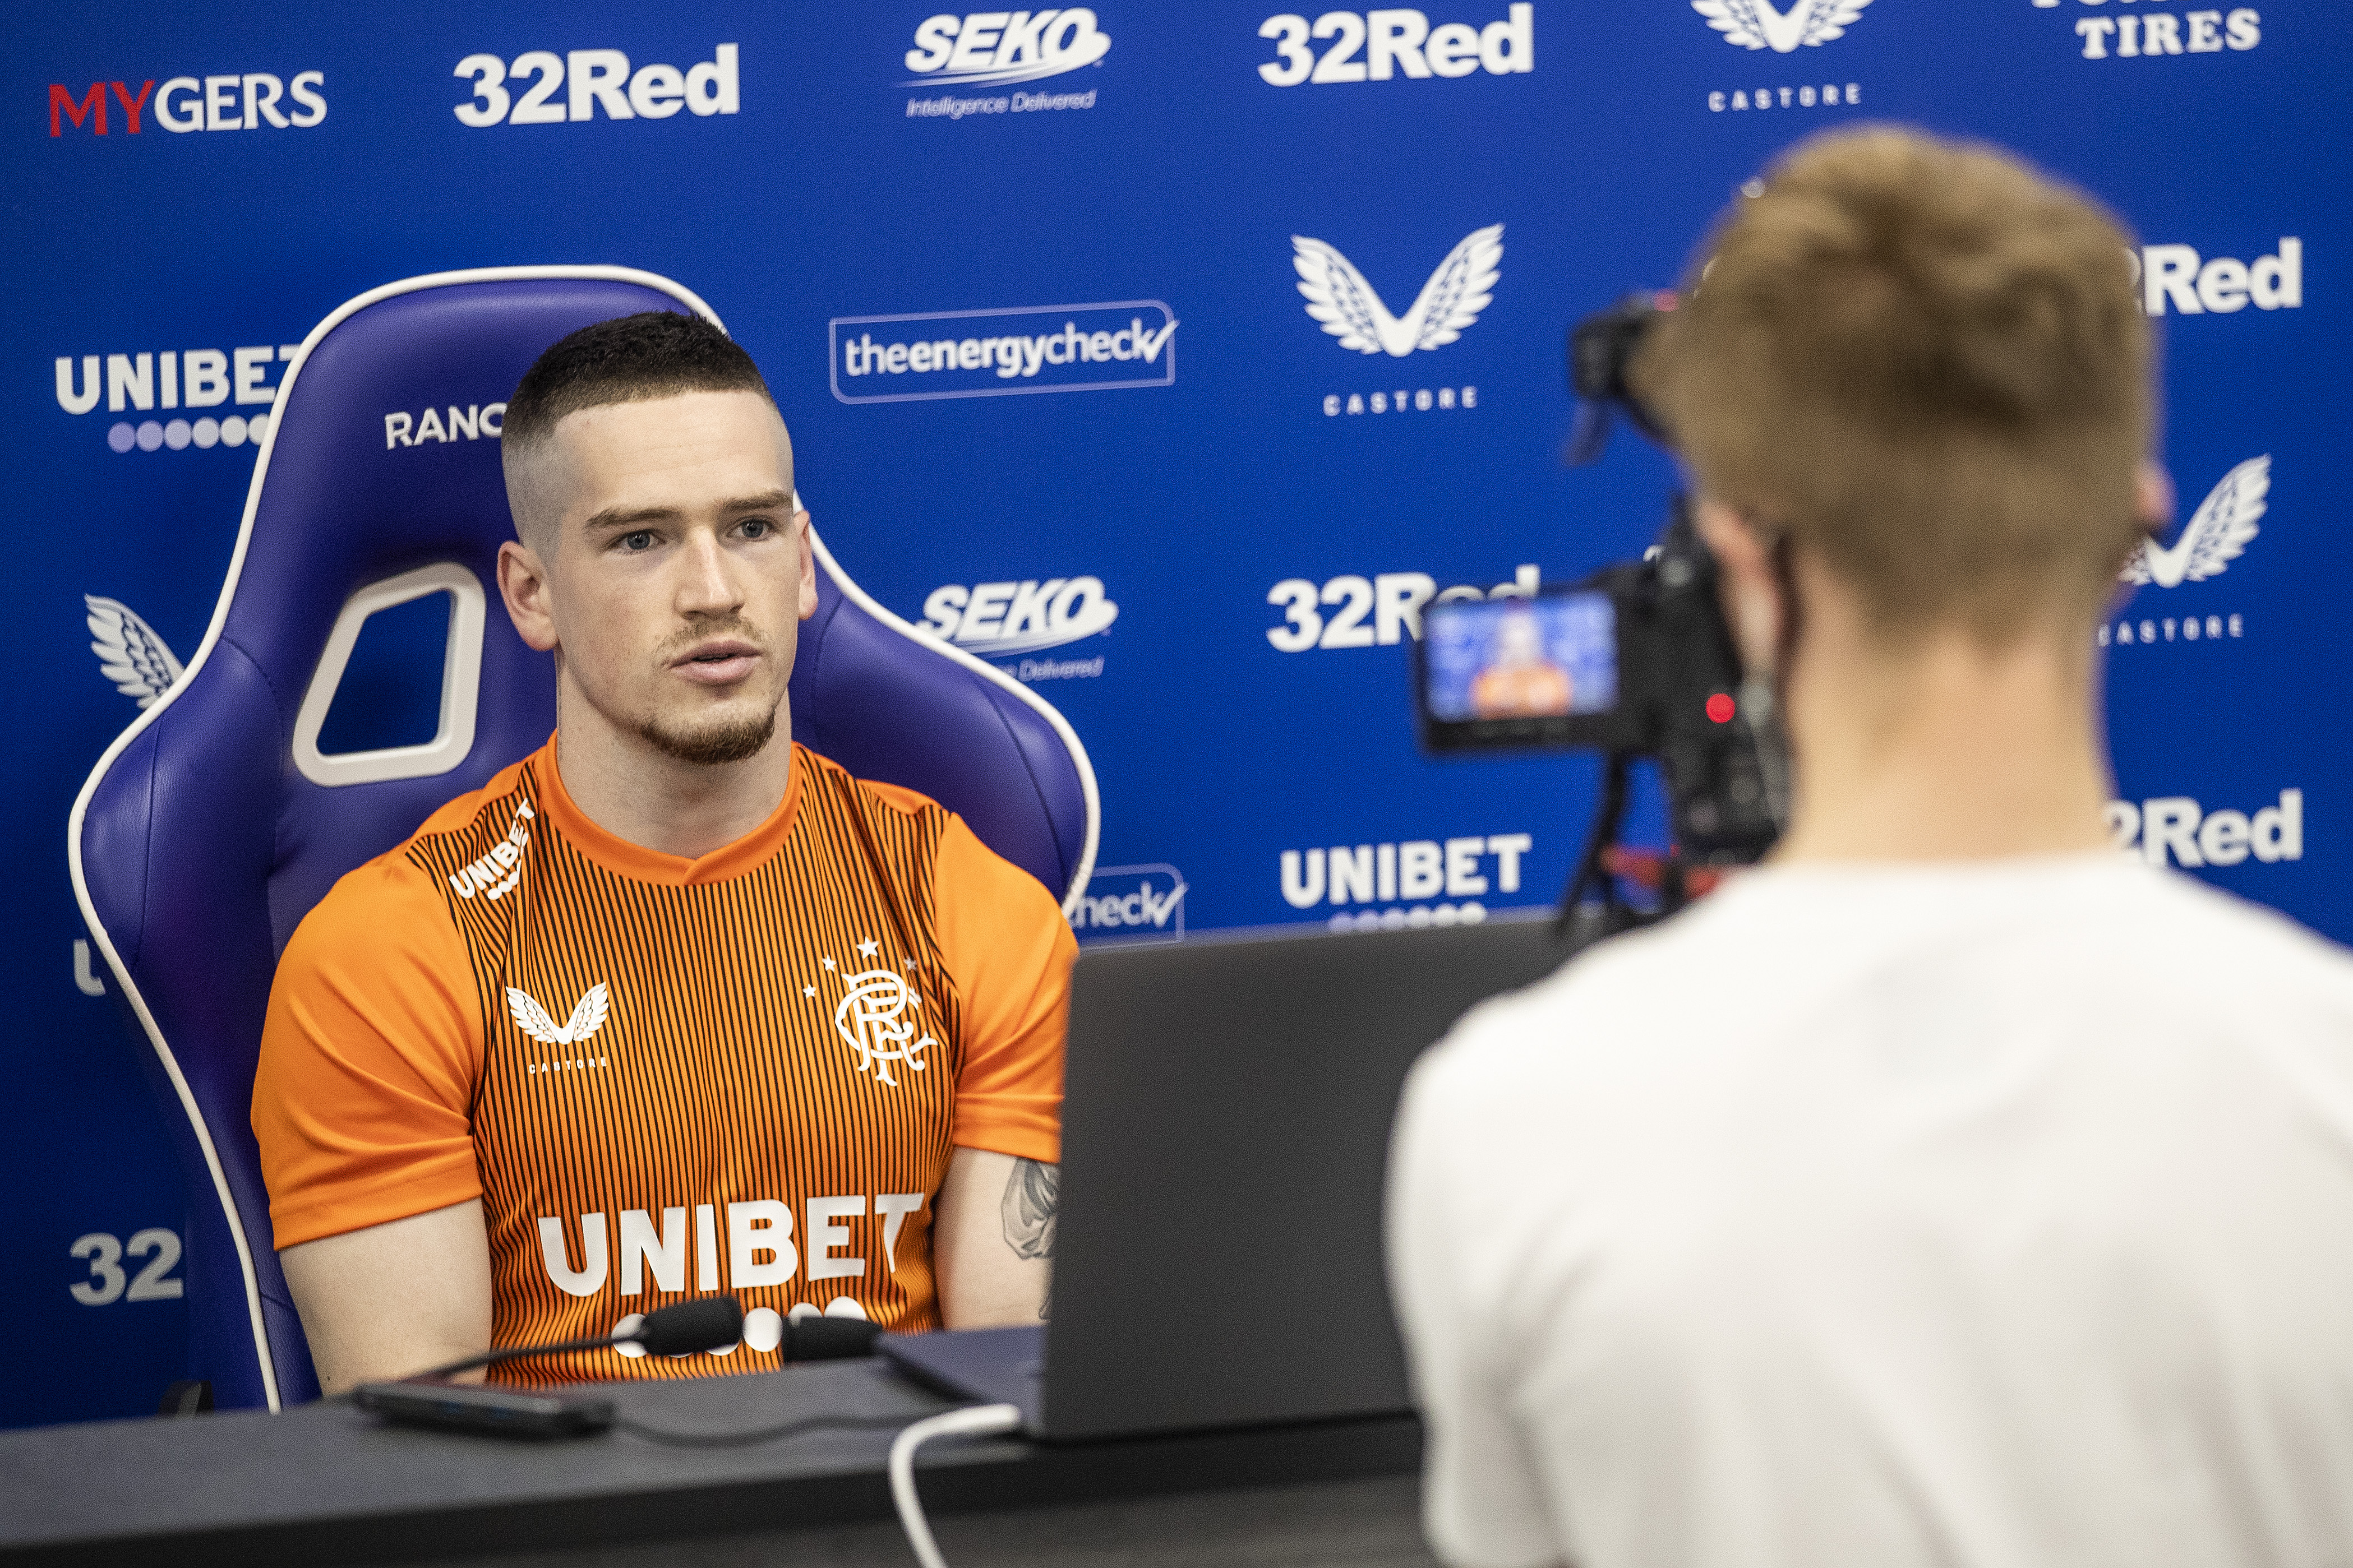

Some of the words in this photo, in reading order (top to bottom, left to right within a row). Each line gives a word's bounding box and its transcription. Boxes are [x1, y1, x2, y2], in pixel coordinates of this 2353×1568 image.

[905, 7, 1112, 73] SEKO
[1258, 2, 1534, 86] 32Red
[2075, 8, 2261, 59] TIRES
[49, 71, 327, 137] MYGERS
[454, 43, 739, 127] 32Red
[906, 96, 1009, 120] Intelligence
[1011, 89, 1097, 112] Delivered
[1708, 83, 1861, 112] CASTORE
[2142, 236, 2303, 317] Red
[1323, 386, 1478, 417] CASTORE
[916, 576, 1118, 641] SEKO
[449, 798, 534, 899] UNIBET
[1280, 834, 1532, 908] UNIBET
[529, 1057, 607, 1074] CASTORE
[538, 1192, 925, 1297] UNIBET
